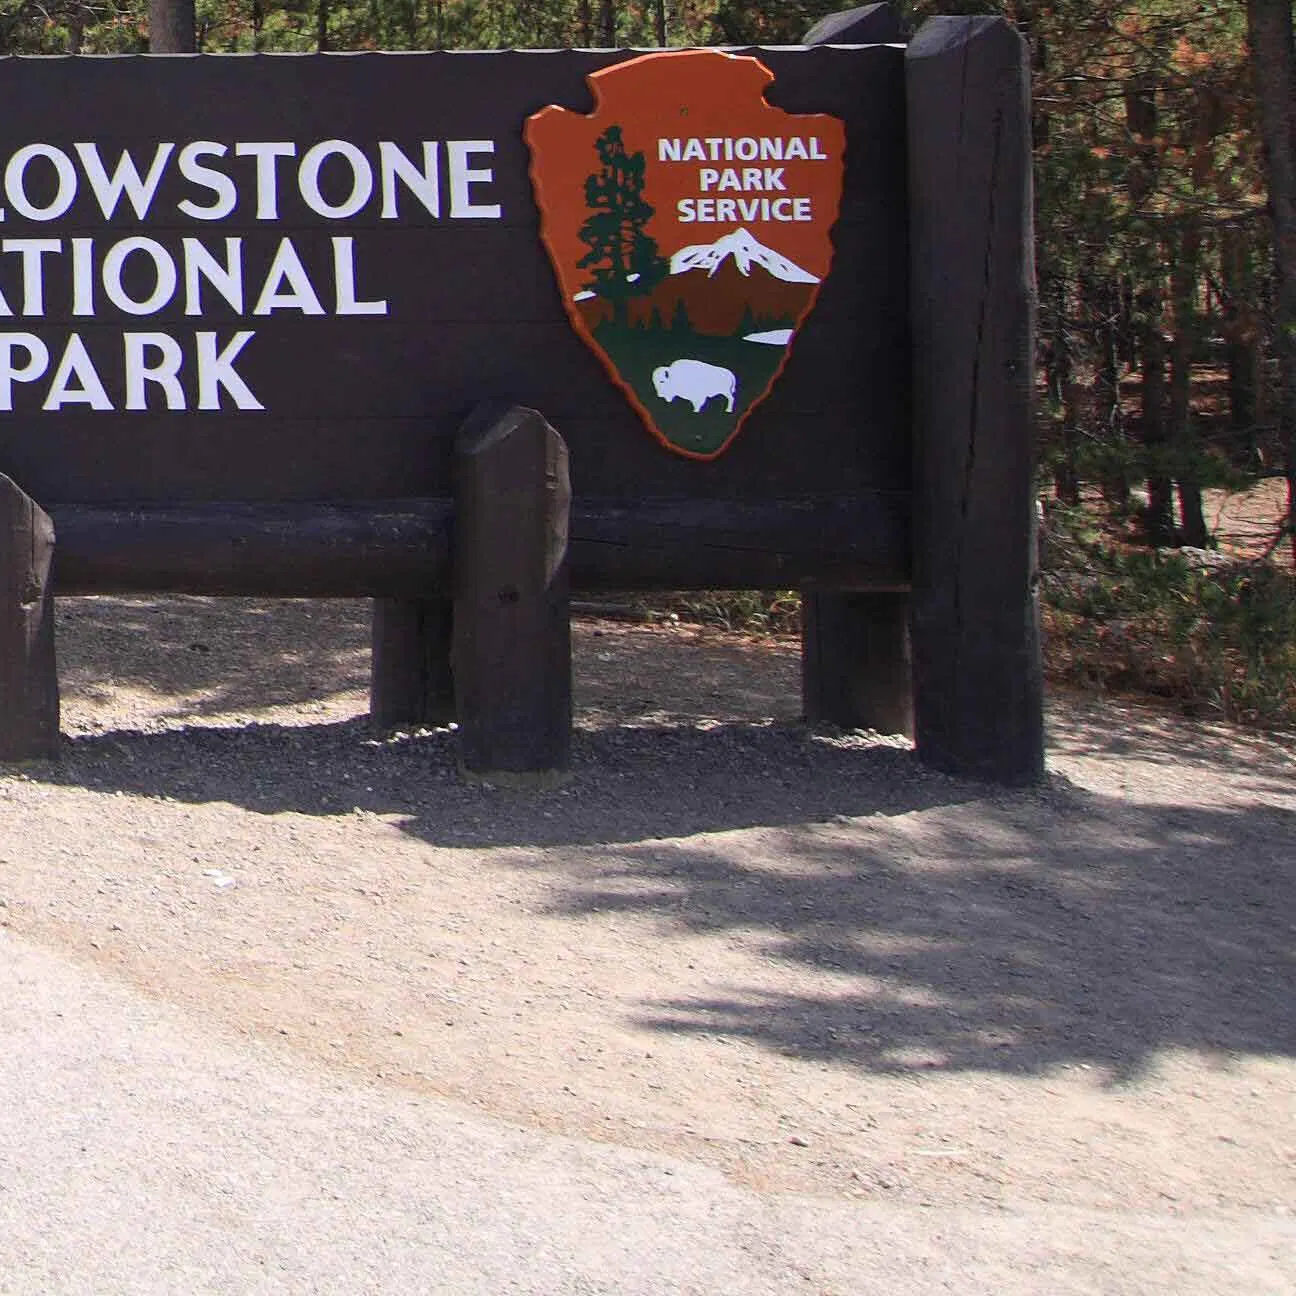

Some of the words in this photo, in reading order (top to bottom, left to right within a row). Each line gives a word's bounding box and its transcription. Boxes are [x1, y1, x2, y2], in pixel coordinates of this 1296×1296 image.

[659, 137, 827, 161] NATIONAL
[701, 167, 787, 191] PARK
[679, 198, 812, 222] SERVICE
